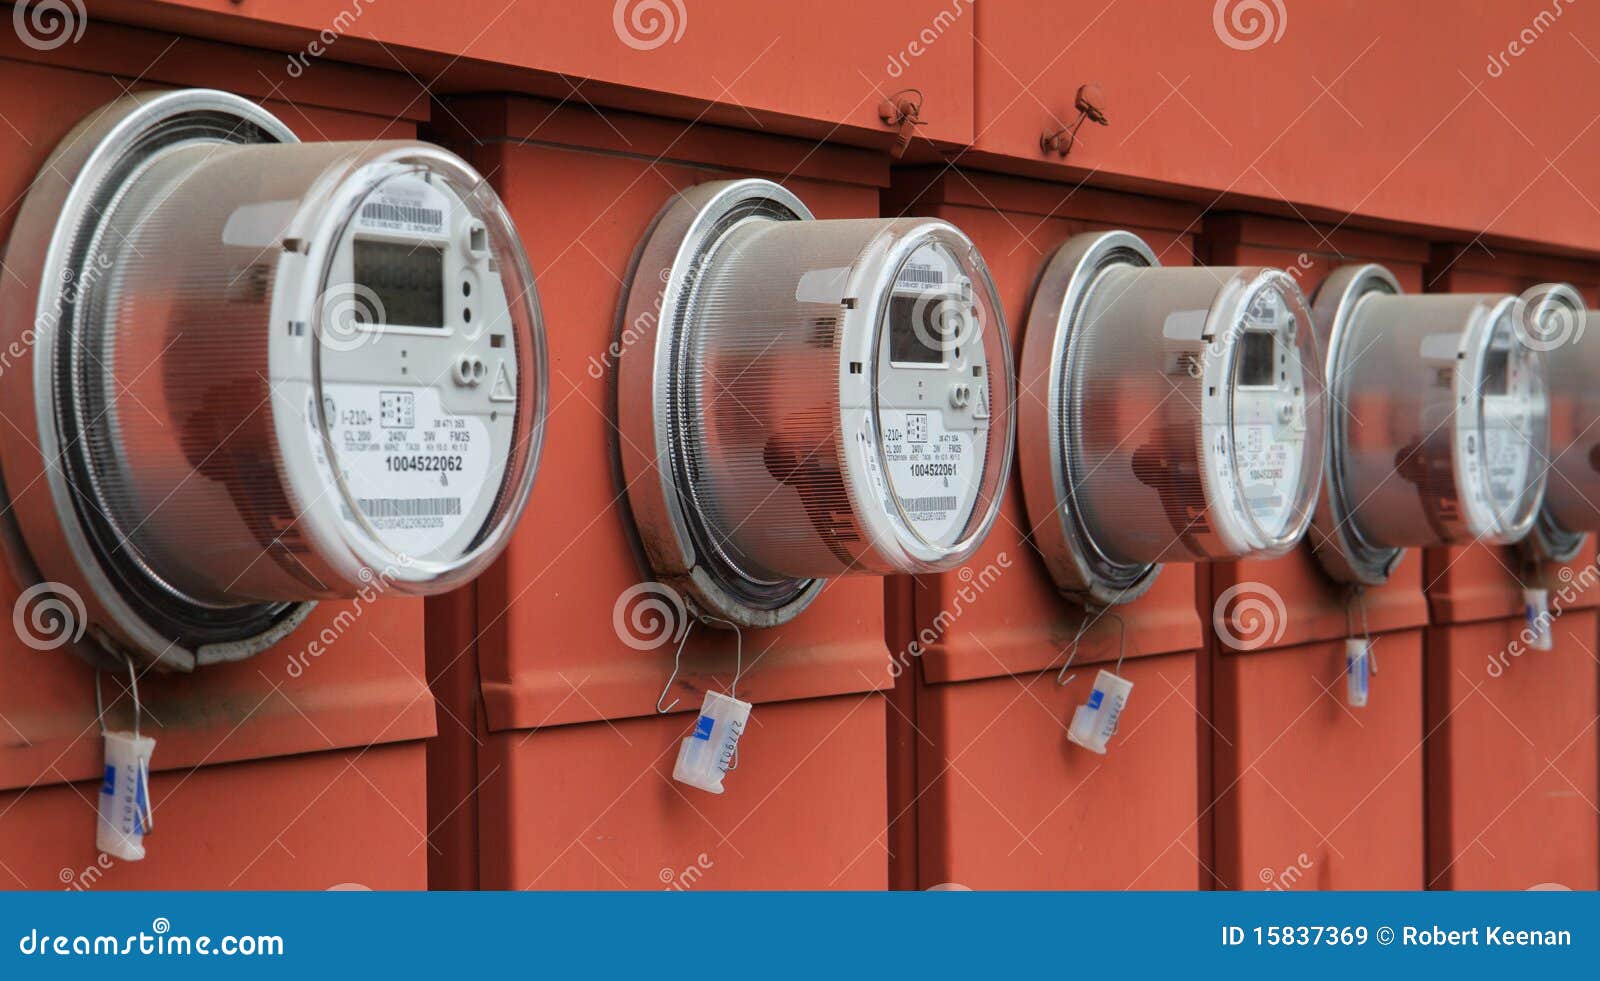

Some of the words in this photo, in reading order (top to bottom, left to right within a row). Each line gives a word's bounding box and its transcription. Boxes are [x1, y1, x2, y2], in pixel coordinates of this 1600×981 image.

[450, 431, 470, 442] FM2S
[385, 455, 463, 471] 1004522062
[910, 463, 957, 477] 1004522061
[717, 720, 742, 773] 2779017
